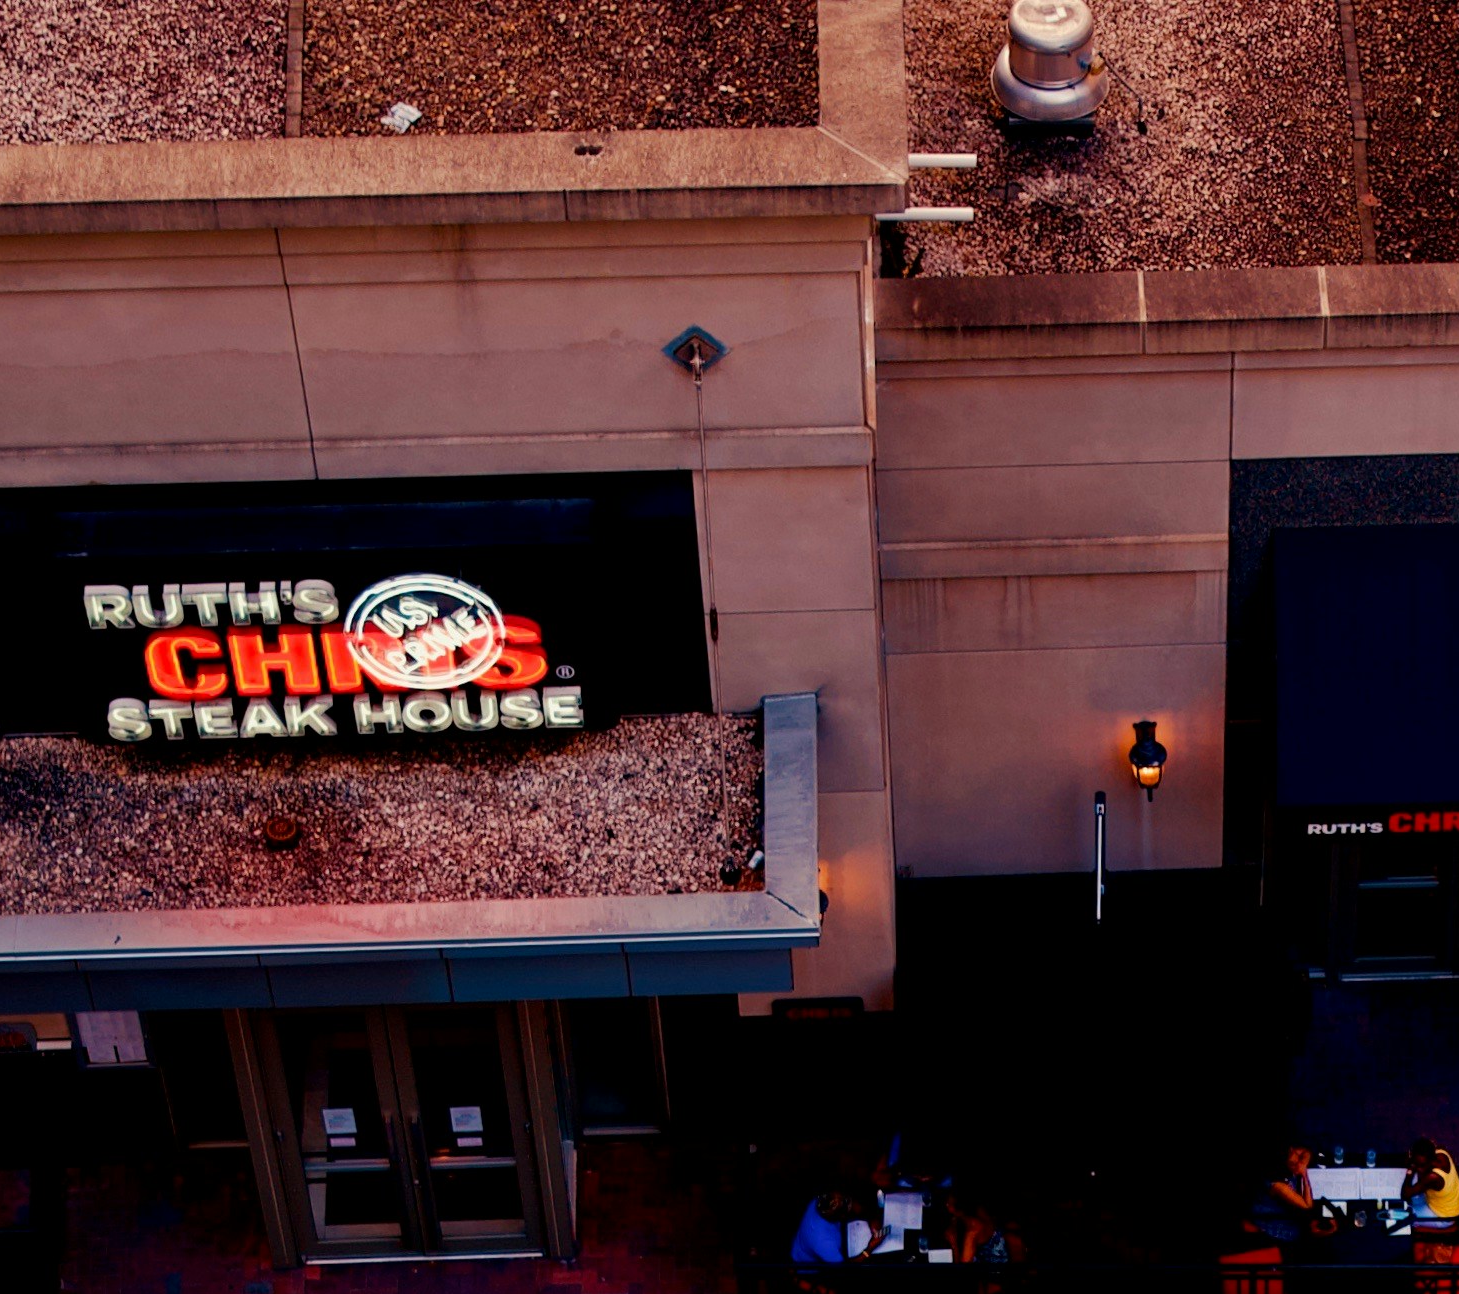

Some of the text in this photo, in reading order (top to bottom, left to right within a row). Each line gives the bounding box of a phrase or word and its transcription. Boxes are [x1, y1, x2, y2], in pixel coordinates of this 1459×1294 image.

[83, 579, 339, 630] RUTH'S
[108, 686, 584, 741] STEAK HOUSE
[1308, 820, 1384, 834] RUTH'S
